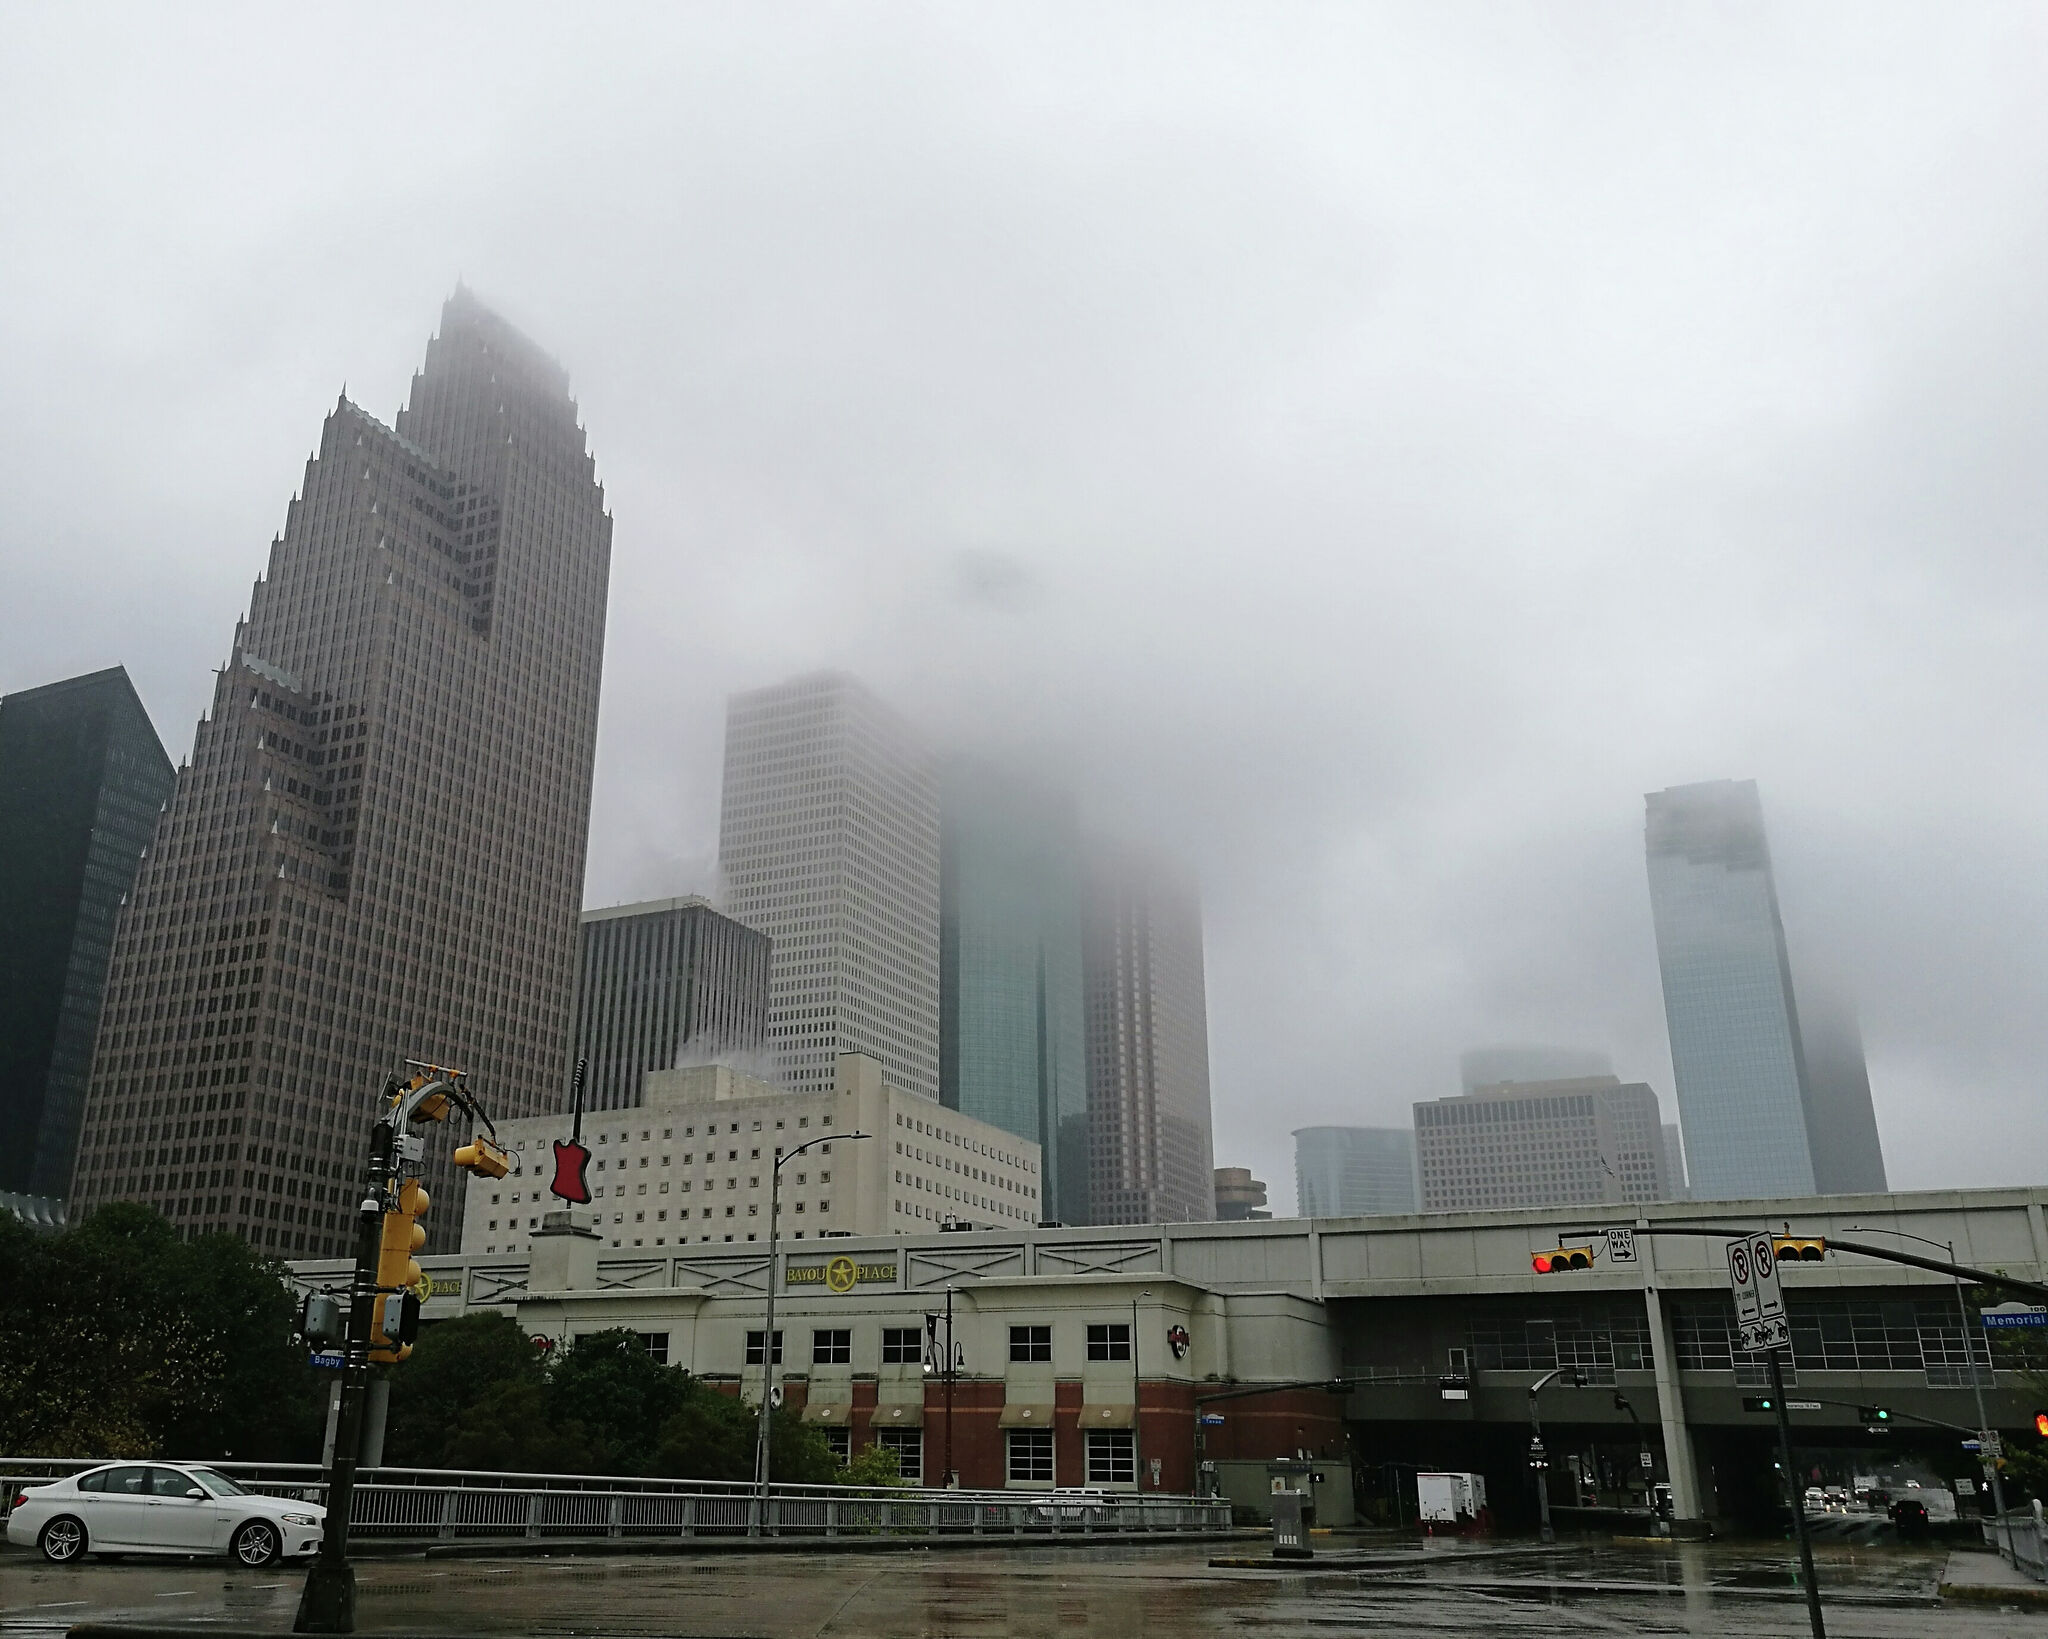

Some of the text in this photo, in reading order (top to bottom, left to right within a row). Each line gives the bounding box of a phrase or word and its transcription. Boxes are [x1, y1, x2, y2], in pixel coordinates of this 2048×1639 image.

[1610, 1230, 1630, 1240] ONE
[1611, 1239, 1631, 1248] WAY
[786, 1265, 898, 1282] BAYOU PLACE
[430, 1280, 462, 1294] PLACE
[1986, 1314, 2046, 1326] Memorial
[314, 1355, 341, 1368] Bagby
